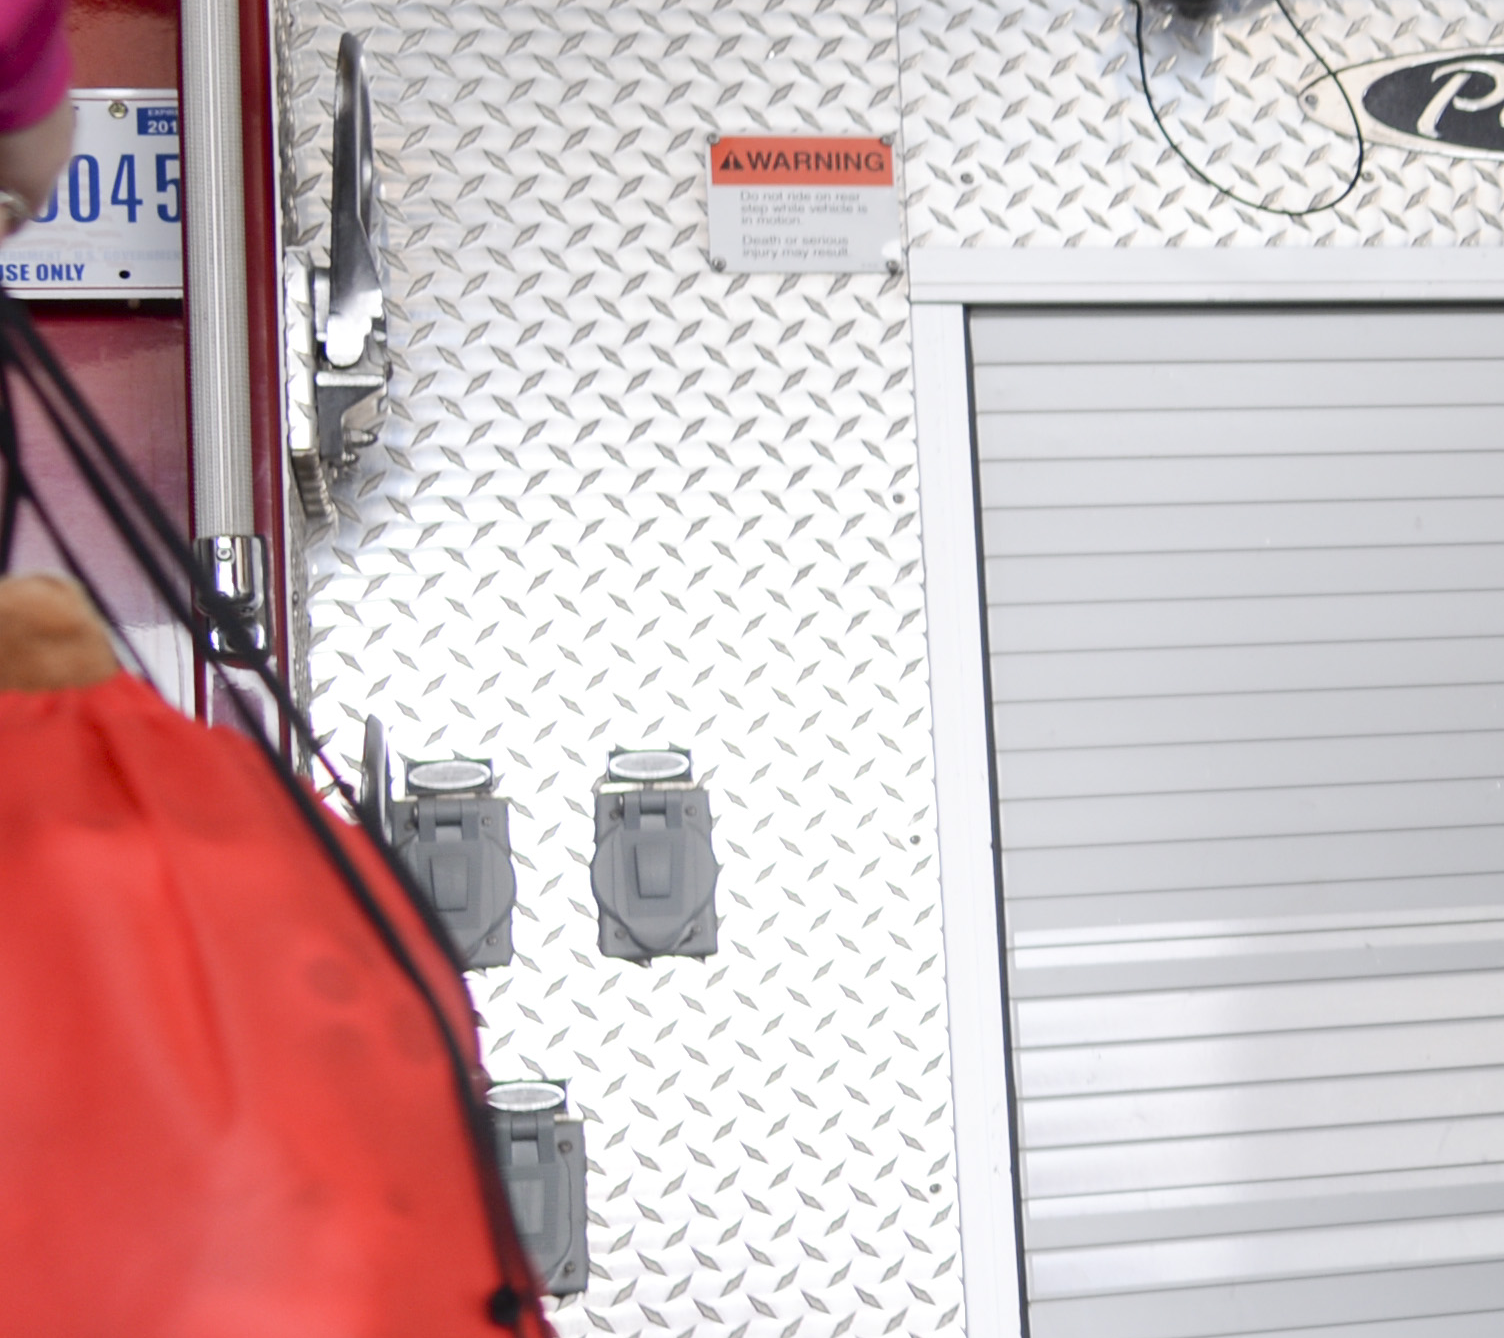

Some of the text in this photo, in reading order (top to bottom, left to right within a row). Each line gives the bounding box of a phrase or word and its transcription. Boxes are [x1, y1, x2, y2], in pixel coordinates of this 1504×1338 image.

[747, 150, 886, 172] WARNING
[740, 190, 860, 202] Do not ride on rear
[741, 203, 868, 215] step while vehicle is
[741, 215, 753, 226] in
[742, 234, 849, 246] Death or serious
[742, 247, 778, 260] injury
[781, 248, 809, 260] may
[36, 263, 85, 282] ONLY
